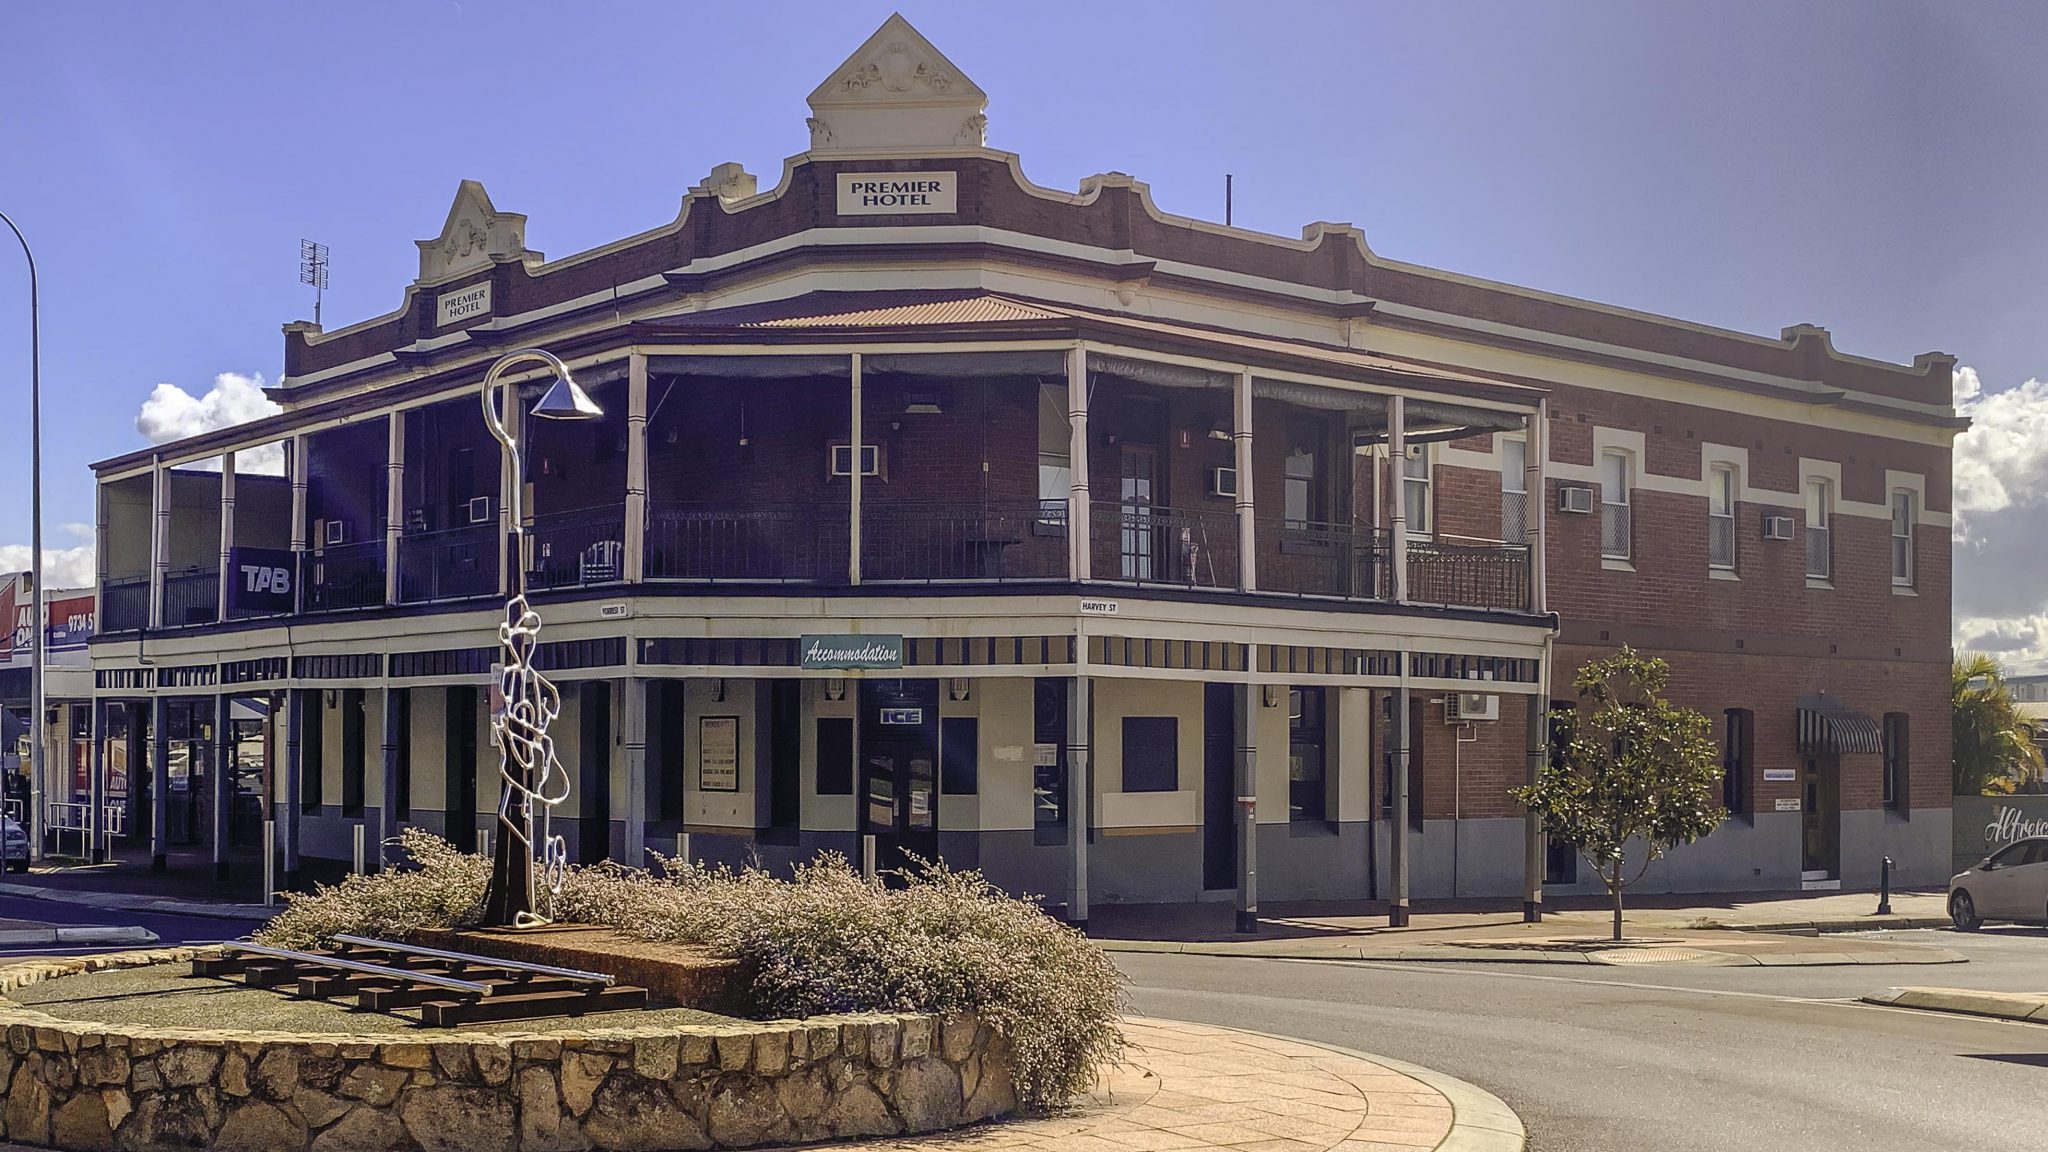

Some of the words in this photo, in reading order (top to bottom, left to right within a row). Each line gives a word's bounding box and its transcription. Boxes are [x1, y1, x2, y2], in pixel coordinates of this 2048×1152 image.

[851, 181, 942, 194] PREMIER
[863, 194, 931, 207] HOTEL
[444, 289, 486, 310] PREMIER
[449, 301, 481, 317] HOTEL
[241, 565, 290, 594] TAB
[1082, 602, 1107, 611] HARVEY
[1109, 603, 1117, 612] ST
[804, 639, 898, 663] Accommodation
[882, 711, 920, 723] ICE
